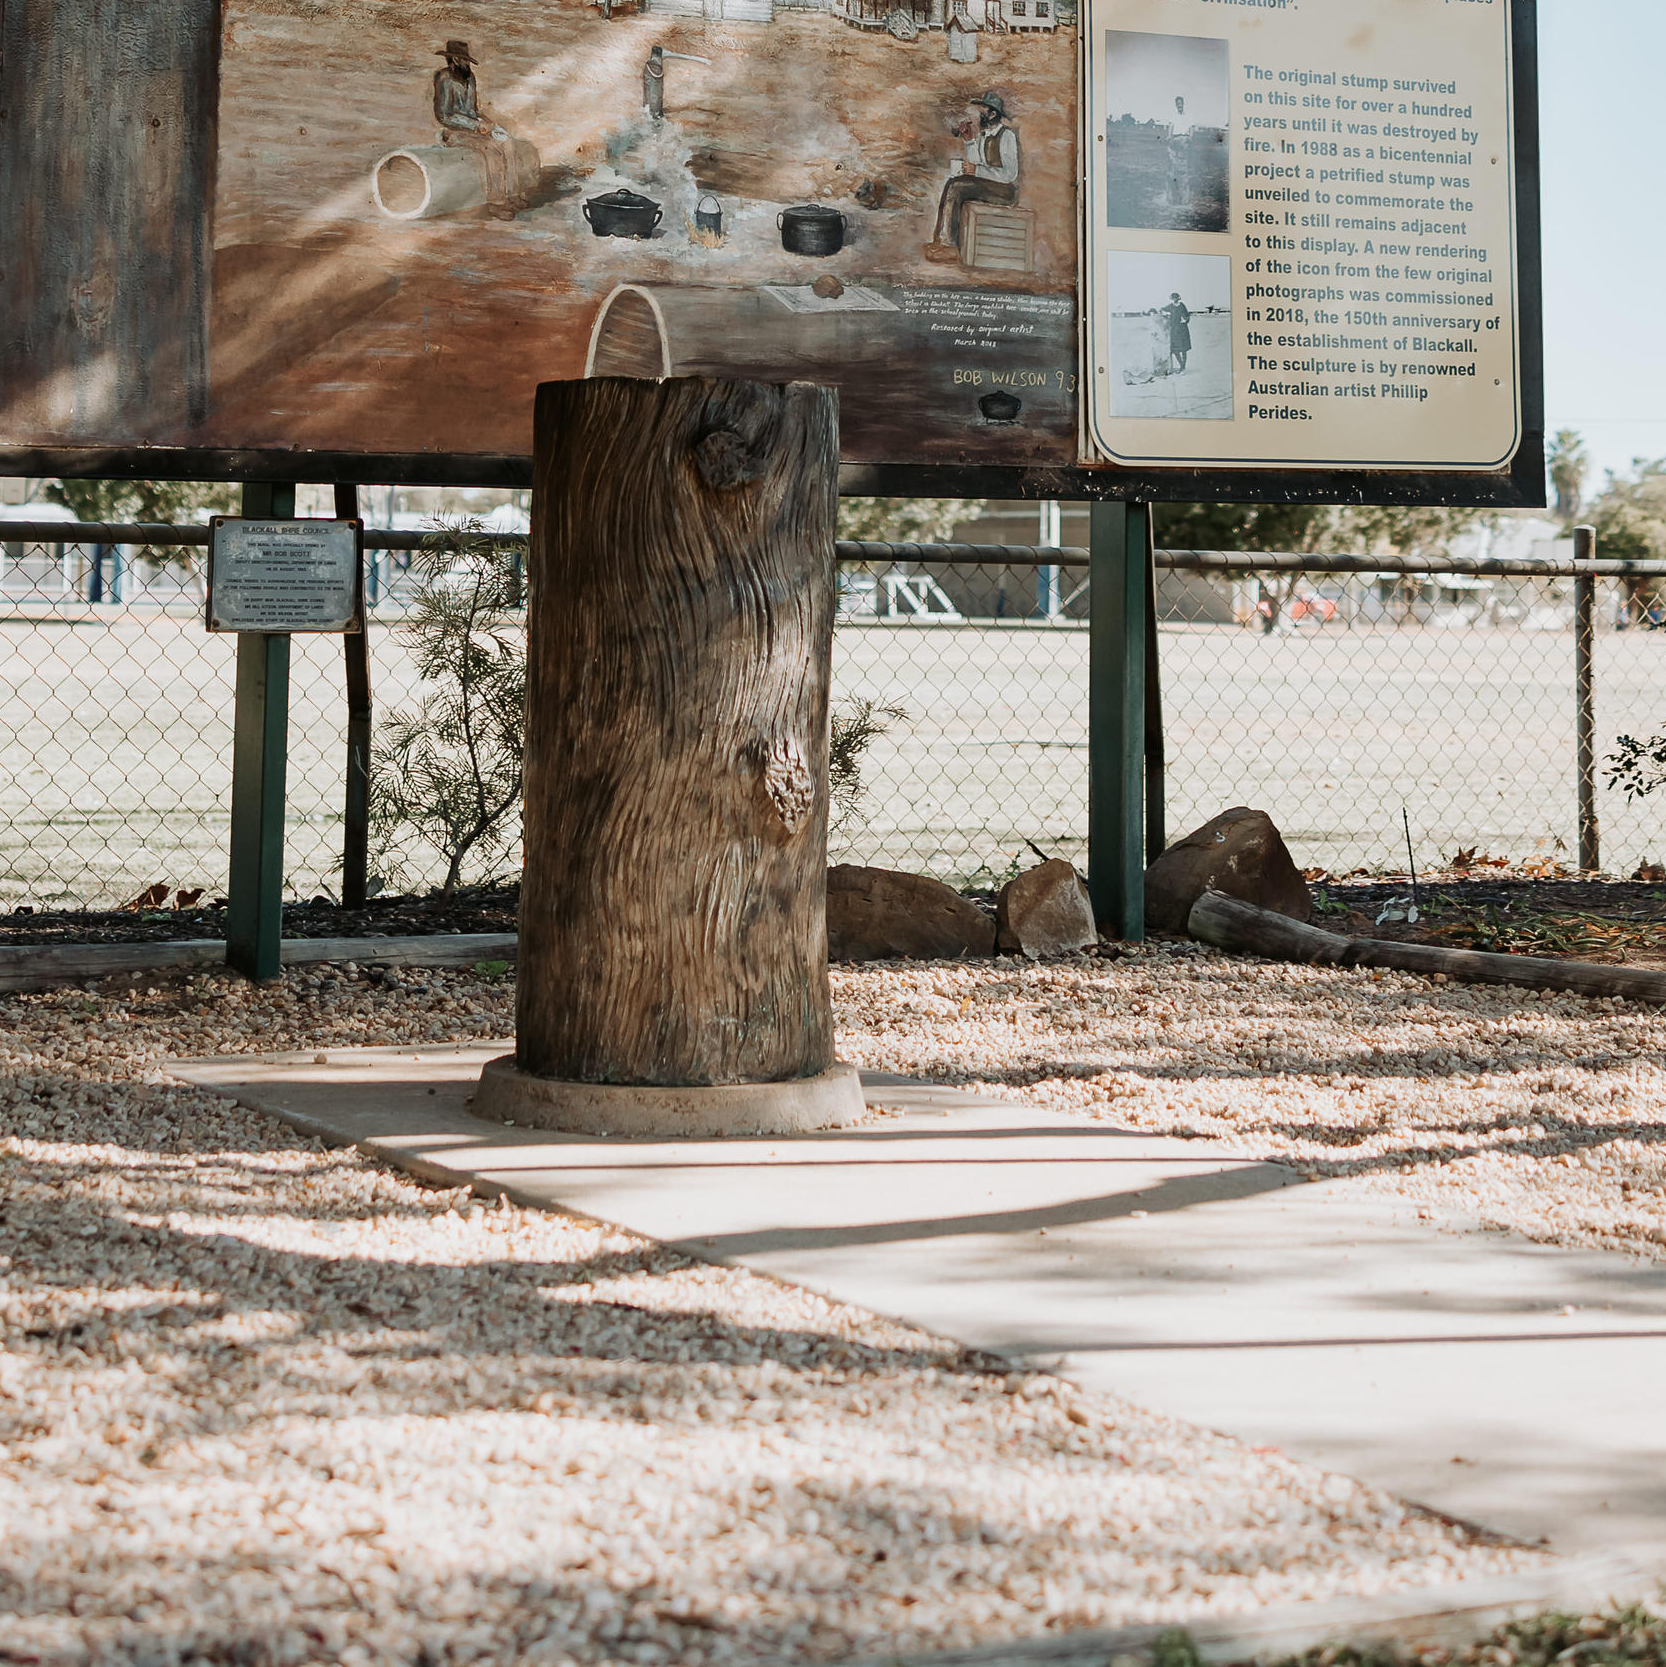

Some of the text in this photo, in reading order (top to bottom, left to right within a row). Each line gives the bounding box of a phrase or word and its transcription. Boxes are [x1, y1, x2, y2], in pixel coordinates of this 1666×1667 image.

[1244, 65, 1455, 94] The original stump survived
[1245, 188, 1473, 211] unveiled to commemorate the
[1245, 210, 1466, 236] site. It still remains adjacent
[1247, 283, 1493, 306] photographs was commissioned
[1247, 307, 1499, 332] in 2018, the 150th anniversary of
[1247, 332, 1477, 352] the establishment of Blackall.
[953, 368, 983, 386] BOB
[991, 370, 1047, 387] WILSON
[1247, 356, 1475, 377] The sculpture is by renowned
[1248, 381, 1427, 402] Australian artist Phillip
[1249, 405, 1311, 419] Perides.
